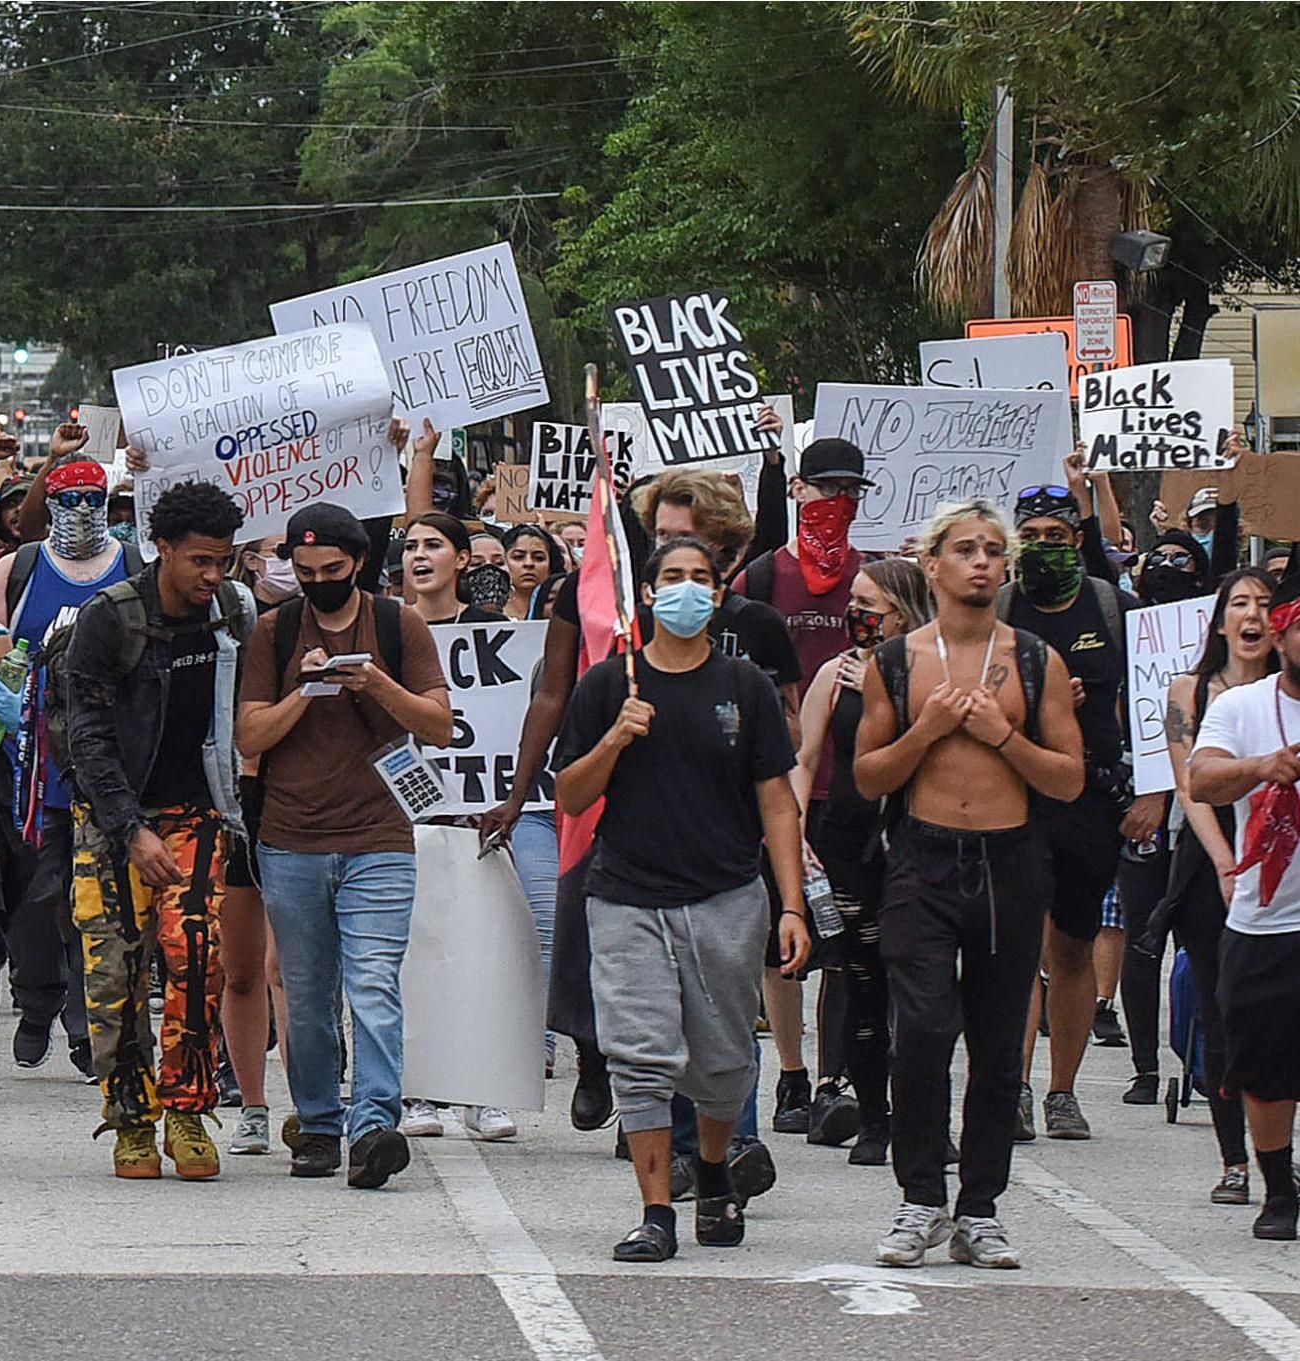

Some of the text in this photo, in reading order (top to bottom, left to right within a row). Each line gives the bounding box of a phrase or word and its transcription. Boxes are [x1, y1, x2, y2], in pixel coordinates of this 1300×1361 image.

[382, 259, 517, 342] FREEDOM
[1076, 287, 1089, 303] NO
[615, 294, 742, 355] BLACK
[138, 332, 342, 417] DON'T CONFUSE
[455, 325, 546, 400] EQUAL
[636, 351, 758, 410] LIVES
[180, 393, 263, 445] REACTION
[278, 379, 300, 412] OF
[316, 371, 356, 400] The
[1084, 369, 1173, 409] Black
[840, 398, 915, 456] NO
[1121, 410, 1201, 437] Lives
[225, 434, 322, 487] VIOLENCE
[326, 425, 346, 454] OF
[352, 413, 387, 444] The
[538, 454, 631, 489] LIVS
[863, 465, 896, 520] O
[1136, 609, 1165, 654] All
[1135, 655, 1191, 692] Matt
[393, 777, 424, 814] PRESS
[402, 771, 433, 808] PRESS
[413, 766, 443, 802] PRESS
